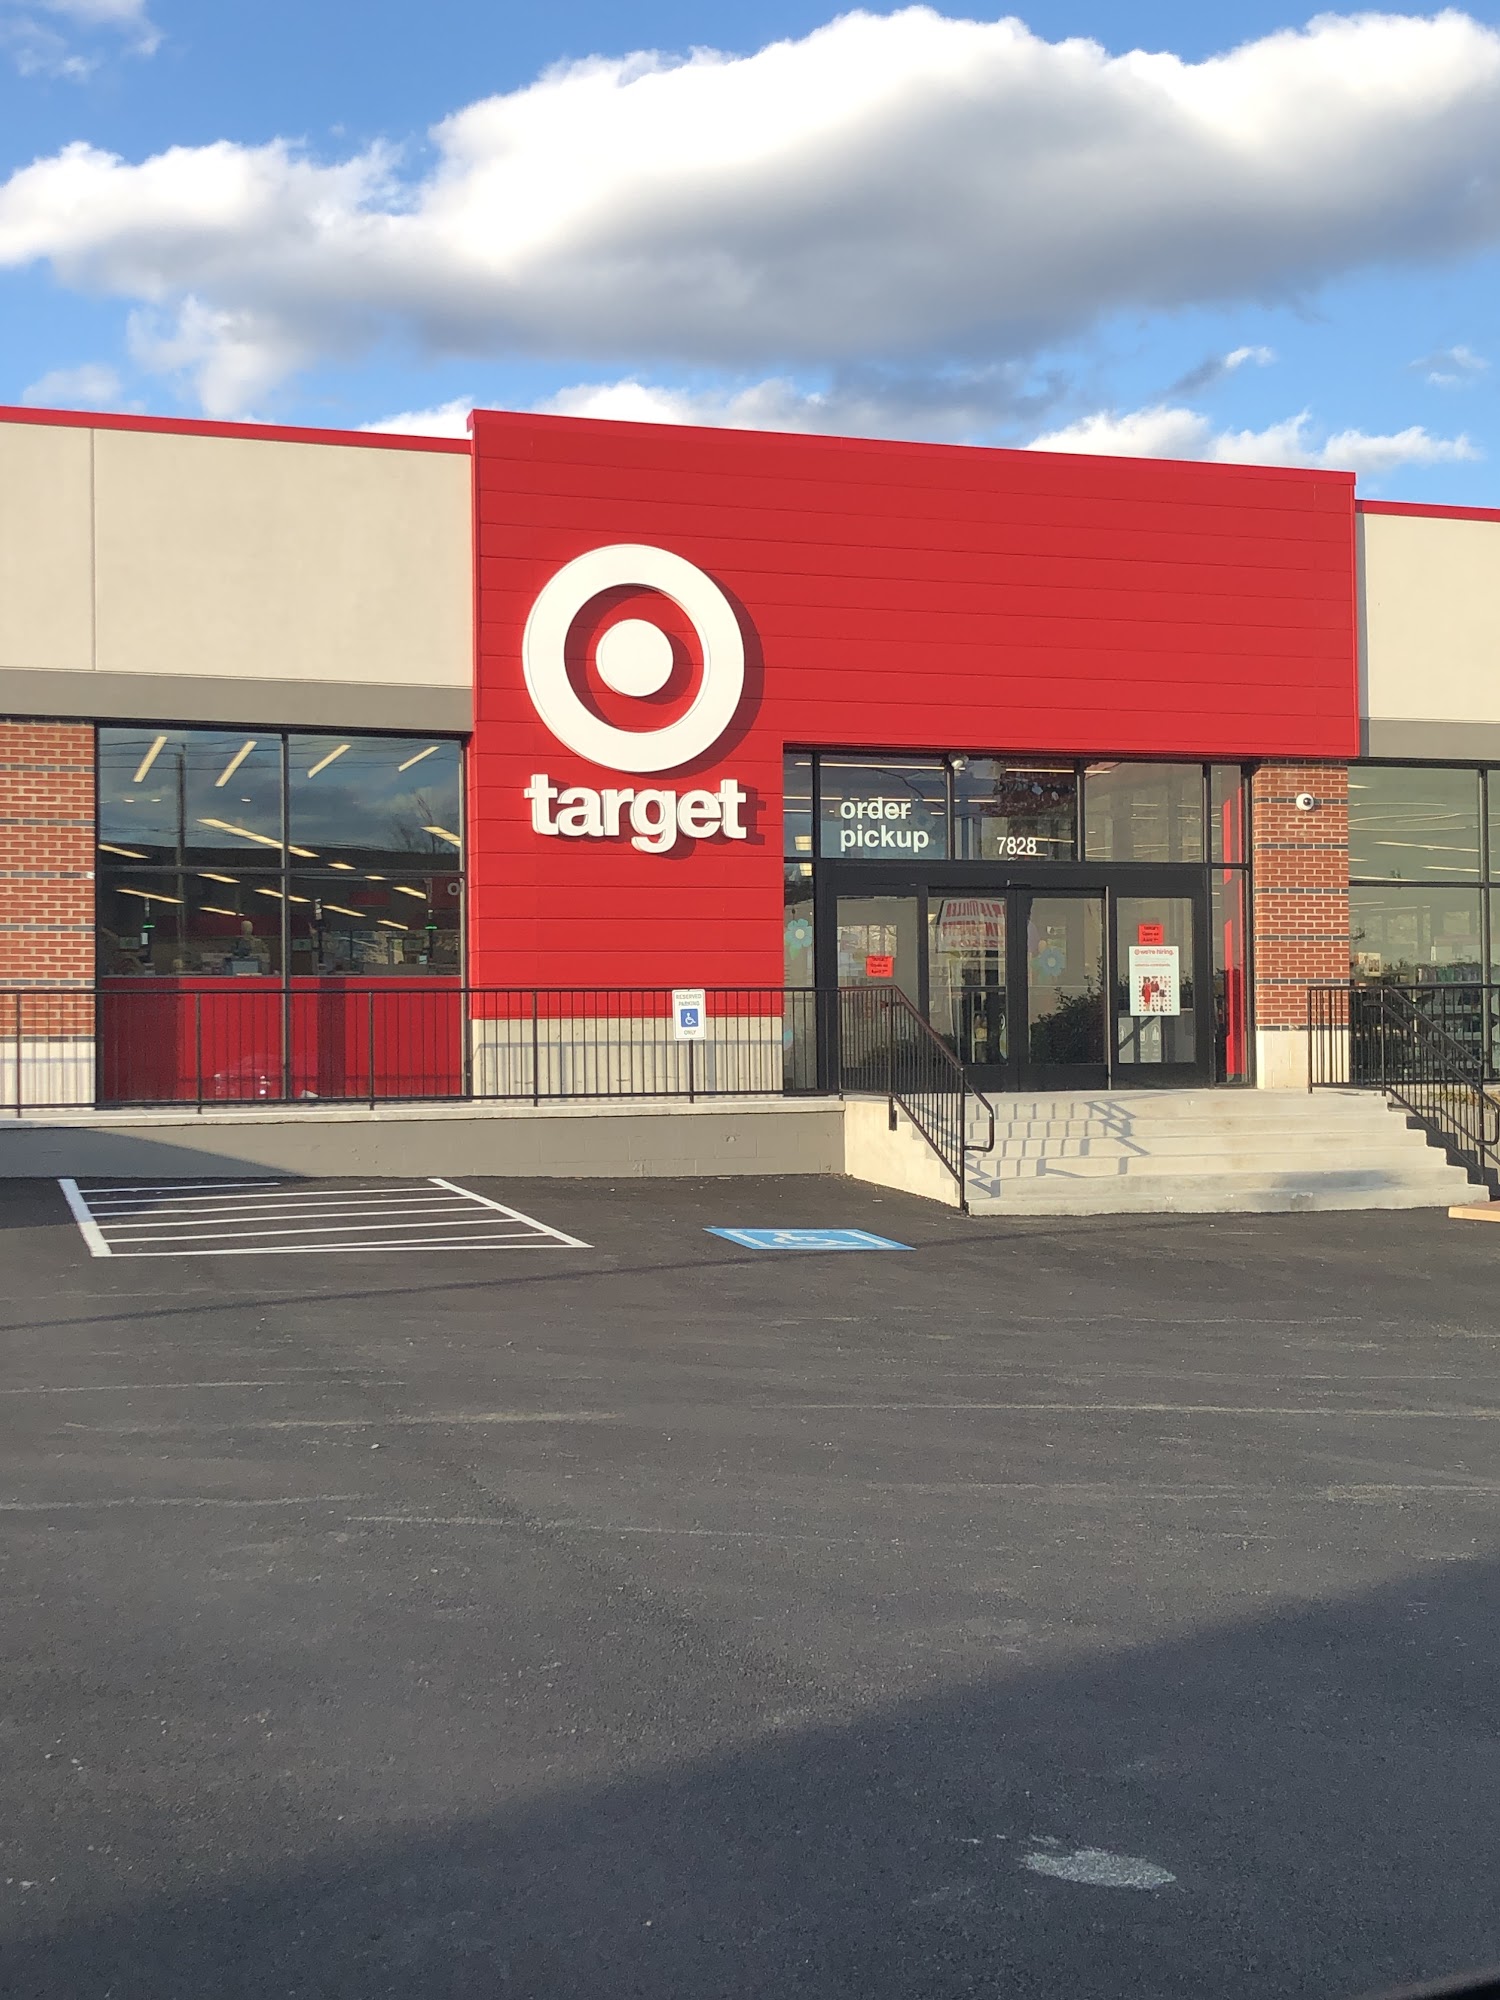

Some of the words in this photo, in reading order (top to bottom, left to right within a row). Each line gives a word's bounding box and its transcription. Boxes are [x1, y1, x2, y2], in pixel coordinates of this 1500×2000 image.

[524, 774, 747, 853] target
[840, 797, 912, 819] order
[840, 824, 929, 853] pickup
[996, 836, 1037, 855] 7828
